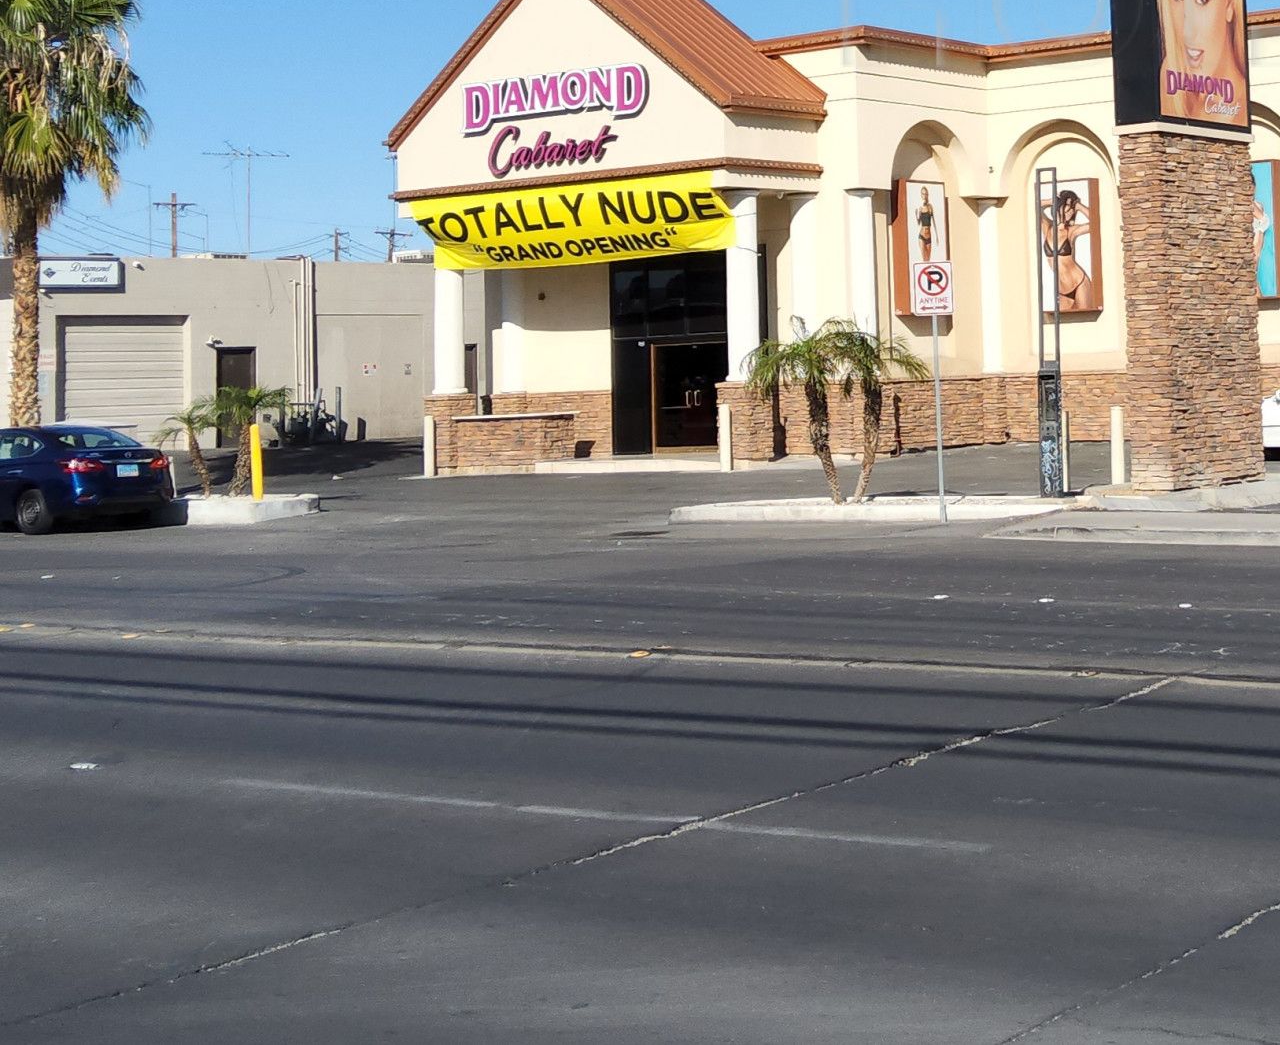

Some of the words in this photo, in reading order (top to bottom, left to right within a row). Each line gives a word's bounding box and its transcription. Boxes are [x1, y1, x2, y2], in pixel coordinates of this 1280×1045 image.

[462, 63, 648, 134] DIAMOND
[1166, 69, 1234, 103] DIAMOND
[1204, 95, 1241, 115] Cabaret
[488, 125, 617, 178] Cabaret
[416, 192, 584, 243] TOTALLY
[597, 191, 725, 225] NUDE
[70, 262, 113, 272] Diamond
[919, 296, 949, 304] ANYTIME
